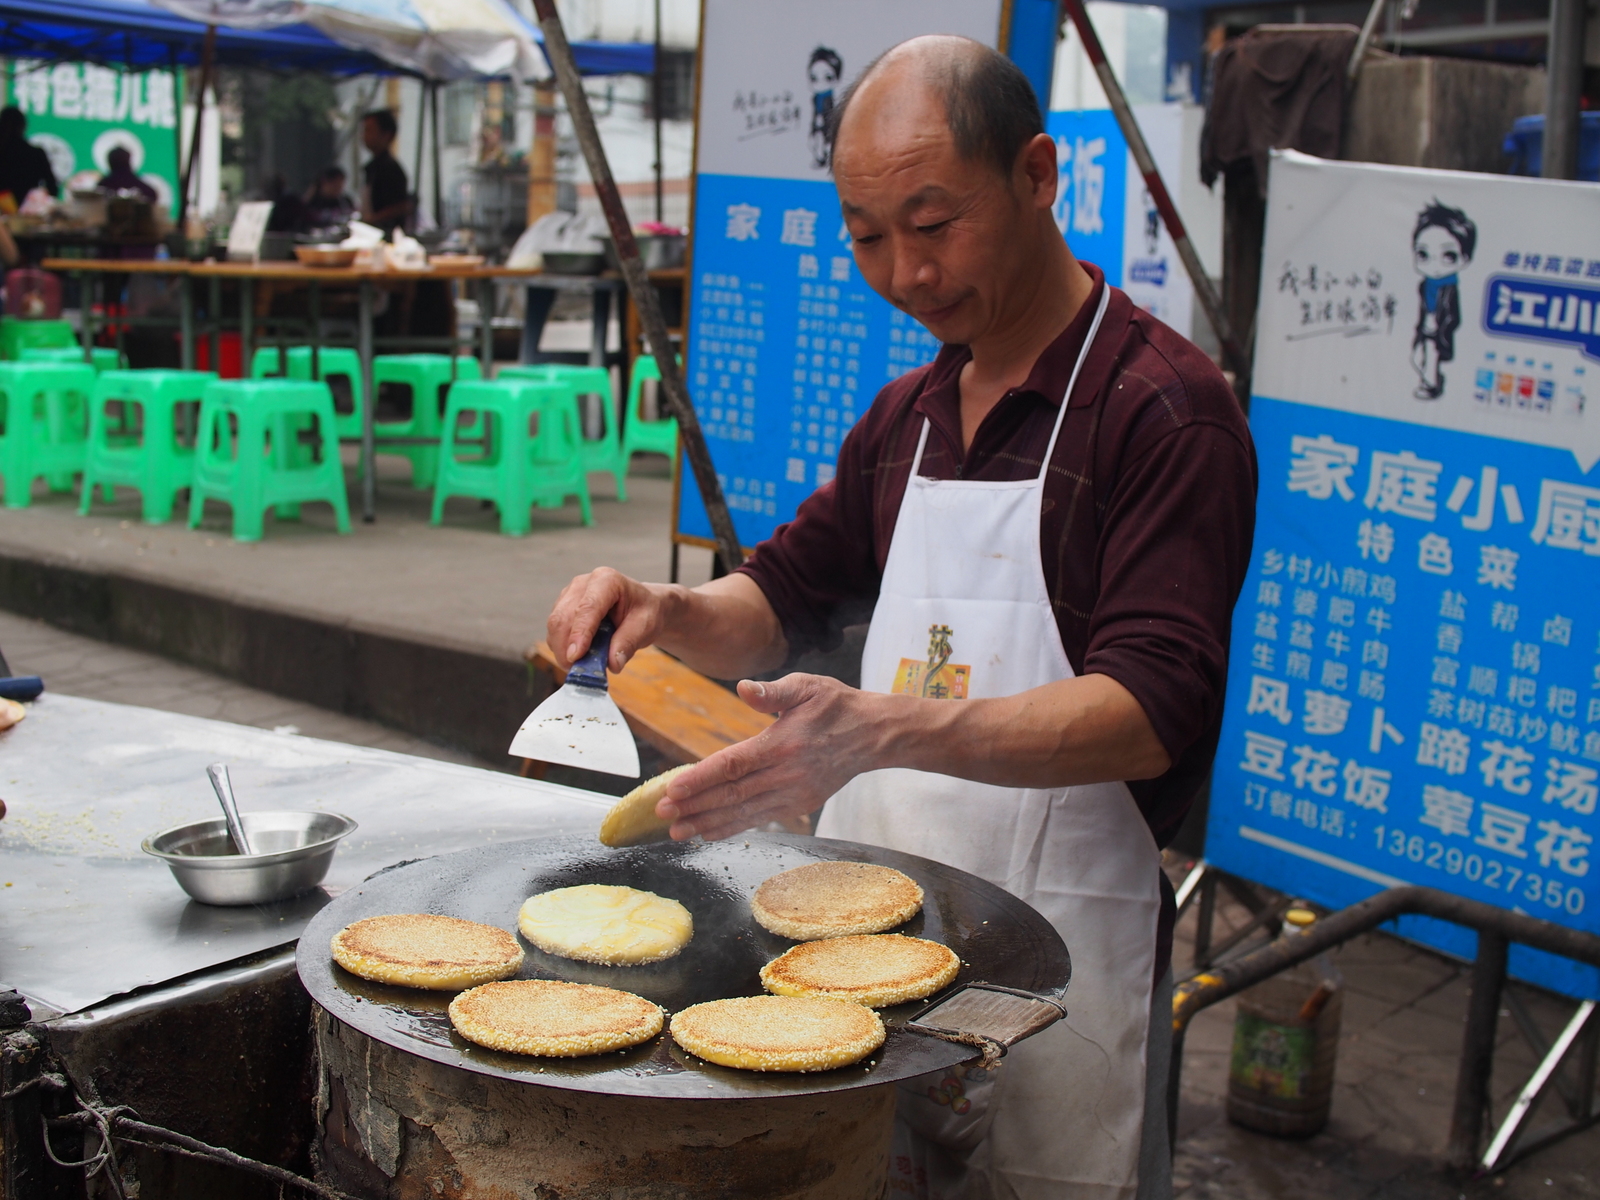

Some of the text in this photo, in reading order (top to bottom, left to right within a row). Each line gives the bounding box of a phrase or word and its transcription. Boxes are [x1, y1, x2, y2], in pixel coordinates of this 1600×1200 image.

[1493, 282, 1600, 336] 江小
[1286, 433, 1600, 557] 家庭小厨
[1261, 548, 1397, 605] 乡村小煎鸡
[1356, 518, 1520, 591] 特色菜
[1439, 589, 1600, 654] 盐帮卤
[1239, 730, 1593, 877] 豆花饭 荤豆花
[1373, 826, 1585, 916] 13629027350
